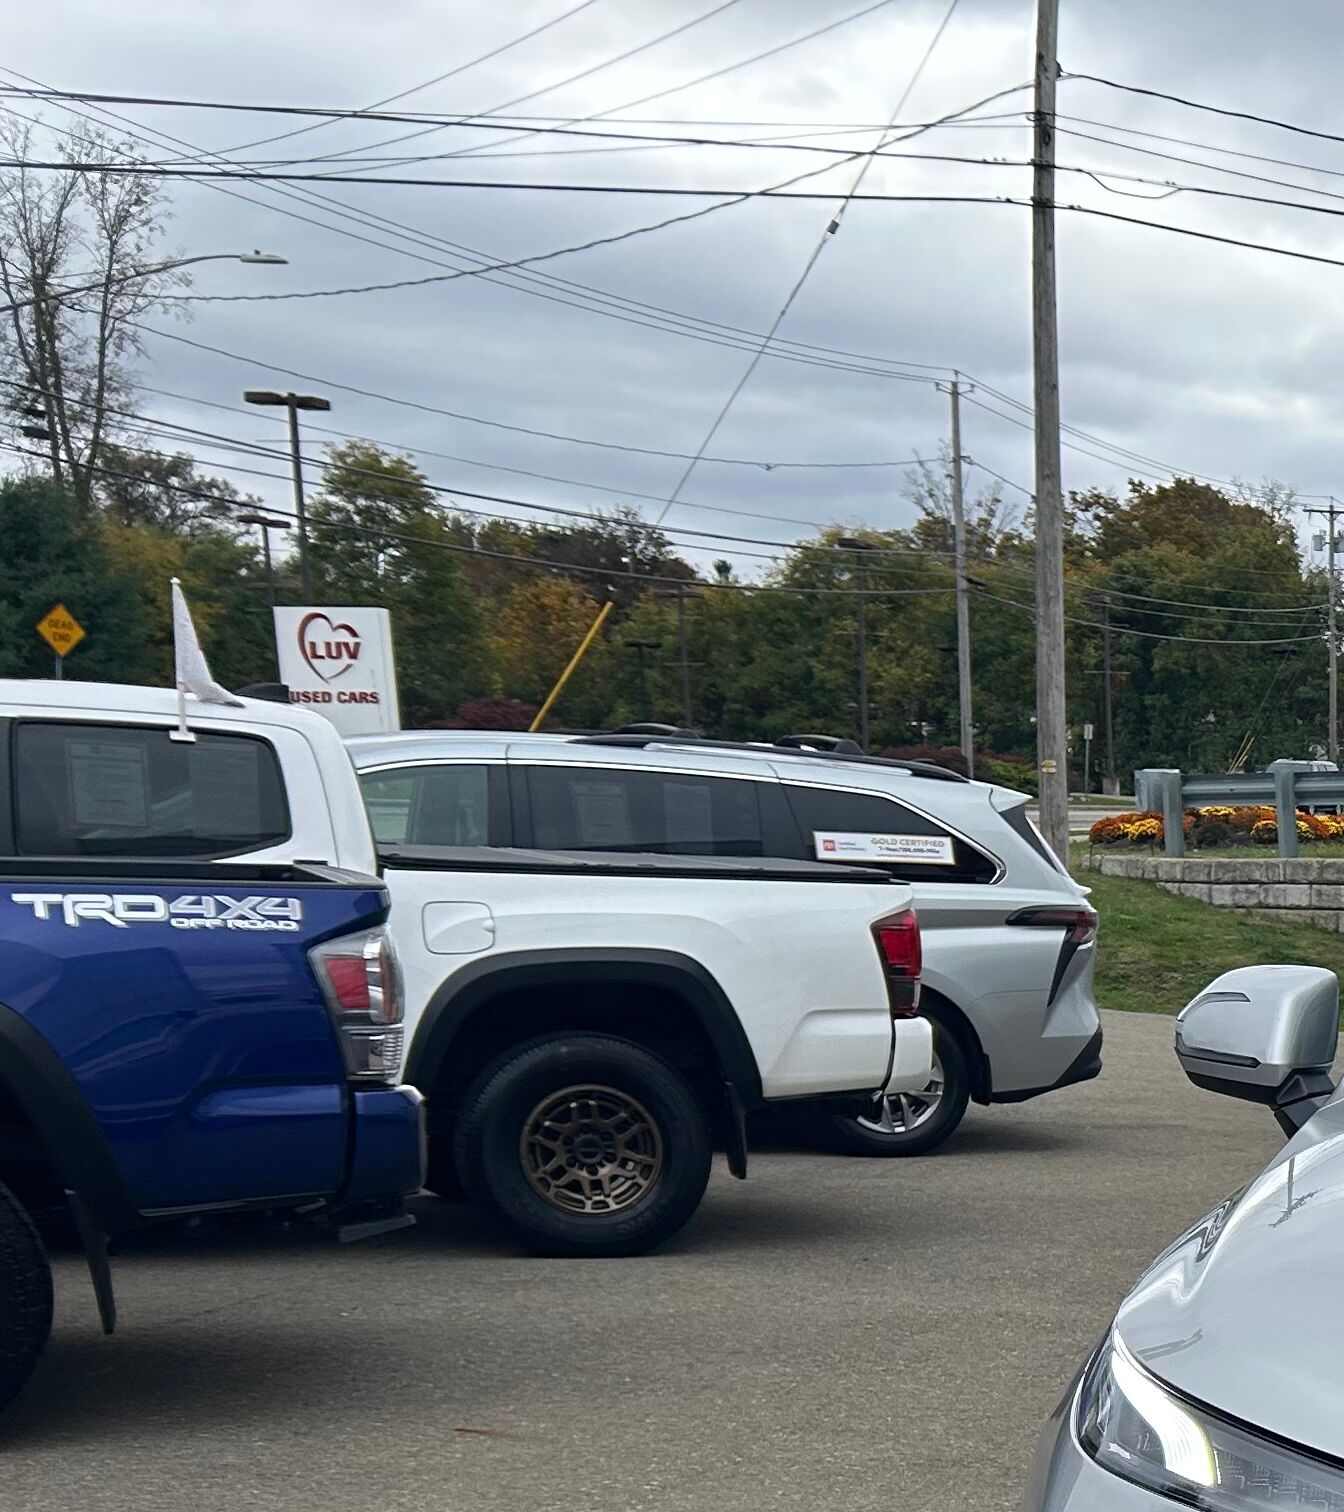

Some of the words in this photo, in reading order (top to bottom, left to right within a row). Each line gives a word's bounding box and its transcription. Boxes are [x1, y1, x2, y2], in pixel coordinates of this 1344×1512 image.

[48, 618, 74, 630] DEAD
[52, 631, 72, 643] END
[308, 641, 362, 660] LUV
[289, 691, 333, 703] USED
[336, 691, 380, 704] CARS
[870, 836, 898, 846] GOLD
[899, 838, 945, 848] CERTIFIED
[11, 892, 170, 929] TRD
[169, 894, 304, 921] 4X4
[170, 917, 228, 930] OFF
[231, 918, 301, 932] ROAD
